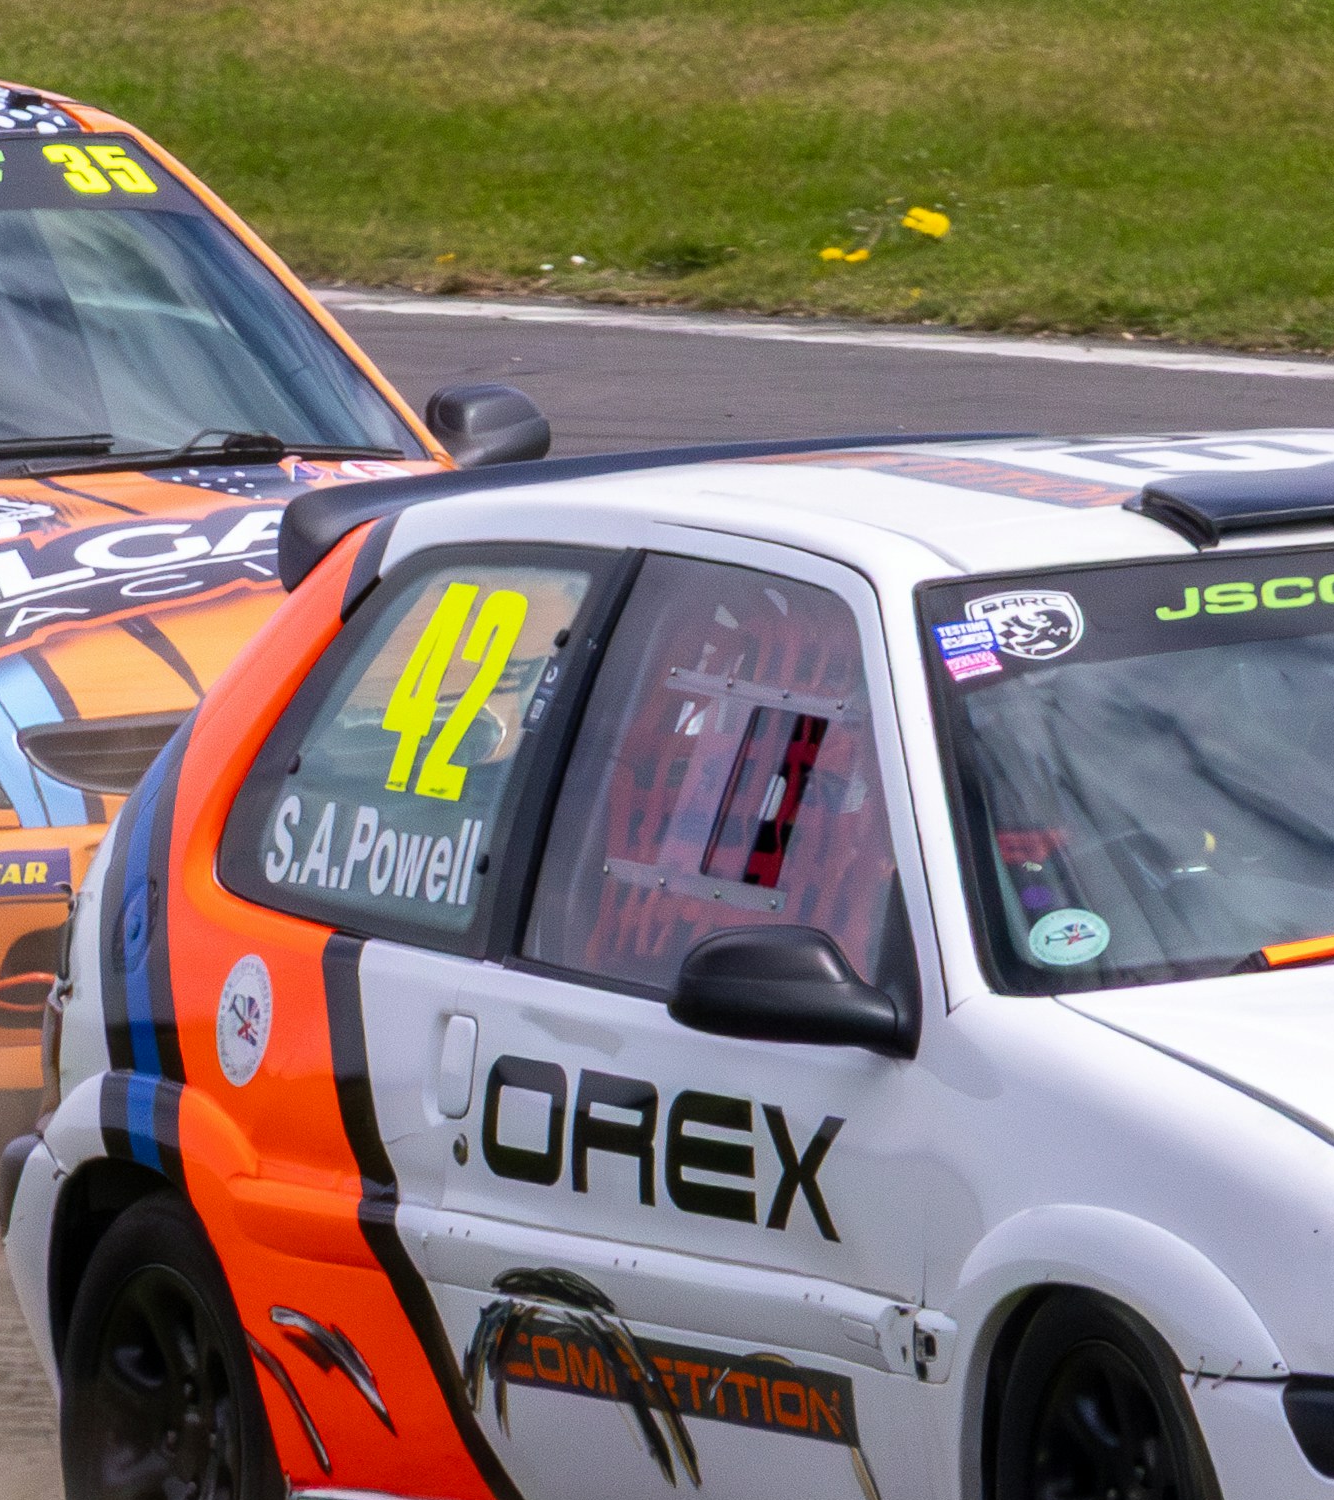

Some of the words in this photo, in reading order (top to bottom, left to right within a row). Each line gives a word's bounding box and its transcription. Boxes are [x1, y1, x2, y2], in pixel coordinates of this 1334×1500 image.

[41, 143, 158, 194] 35
[981, 596, 1062, 614] BARC
[382, 582, 528, 801] 42
[483, 1054, 847, 1243] OREX
